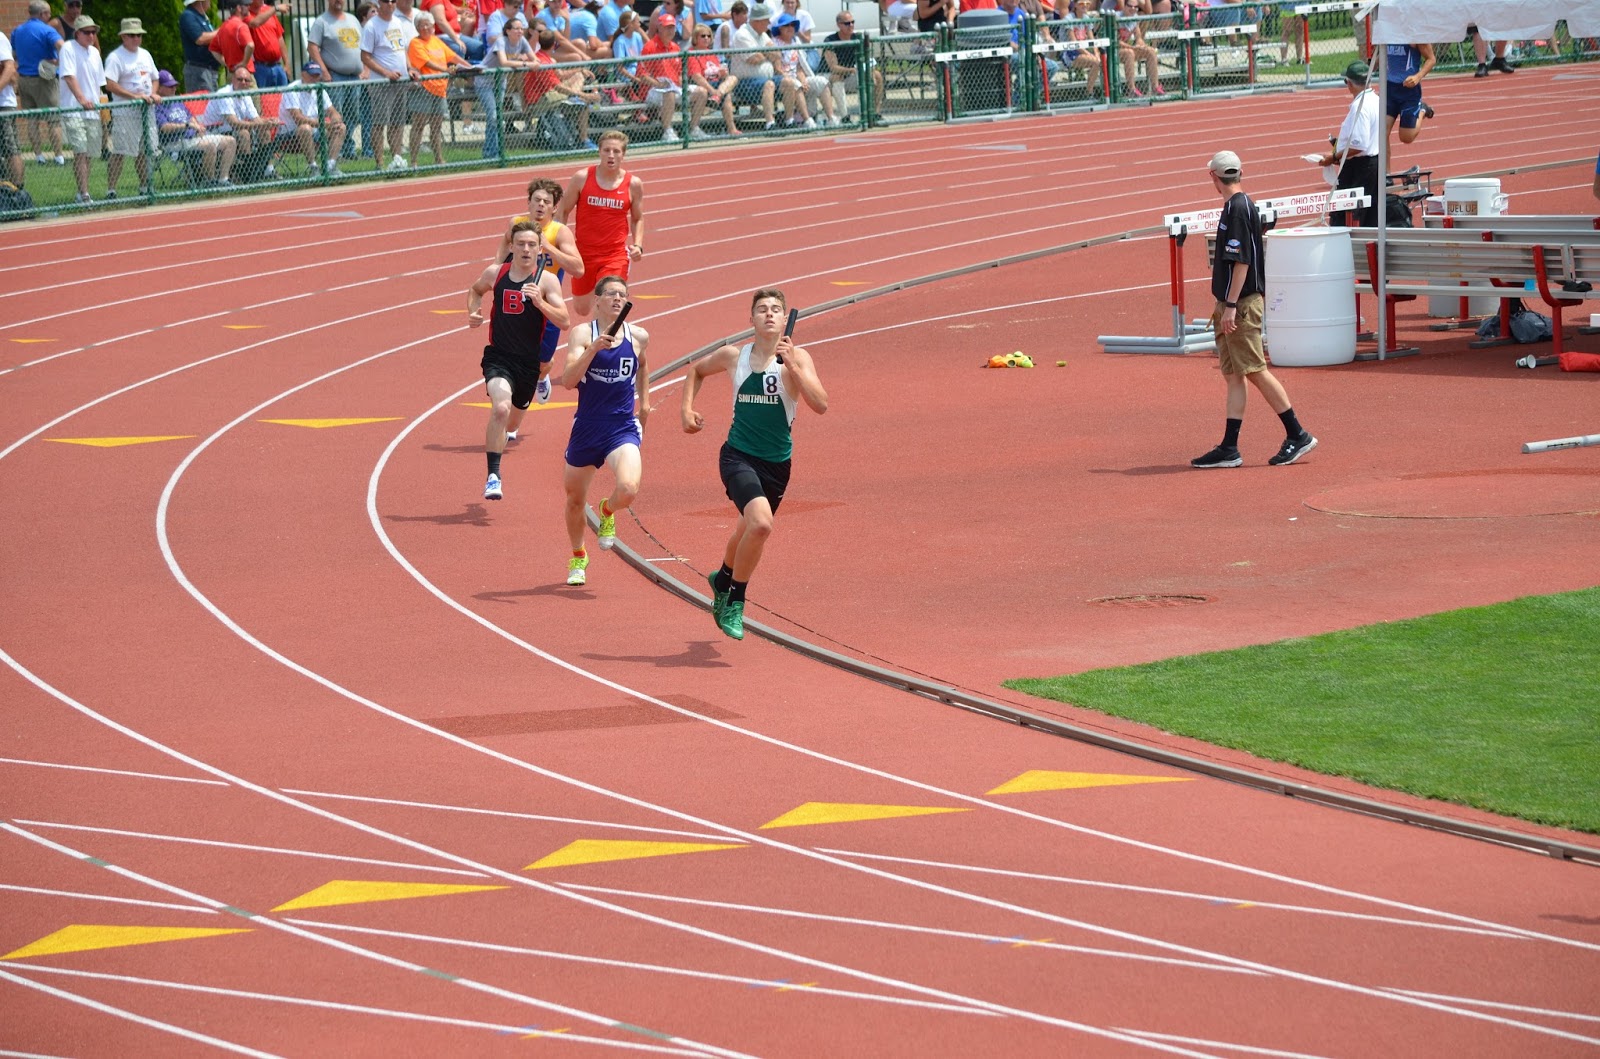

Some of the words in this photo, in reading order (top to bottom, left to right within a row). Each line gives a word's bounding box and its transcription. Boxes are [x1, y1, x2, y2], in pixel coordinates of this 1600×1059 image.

[1208, 28, 1227, 36] UCS
[965, 51, 983, 59] UCS
[587, 195, 624, 209] CEDARVILLE
[1291, 196, 1307, 205] OHIO
[1296, 204, 1314, 214] OHIO
[1315, 202, 1337, 212] STTE
[502, 289, 525, 315] B
[621, 359, 631, 376] 5
[765, 375, 778, 394] 8
[737, 393, 779, 405] SMITHVILLE
